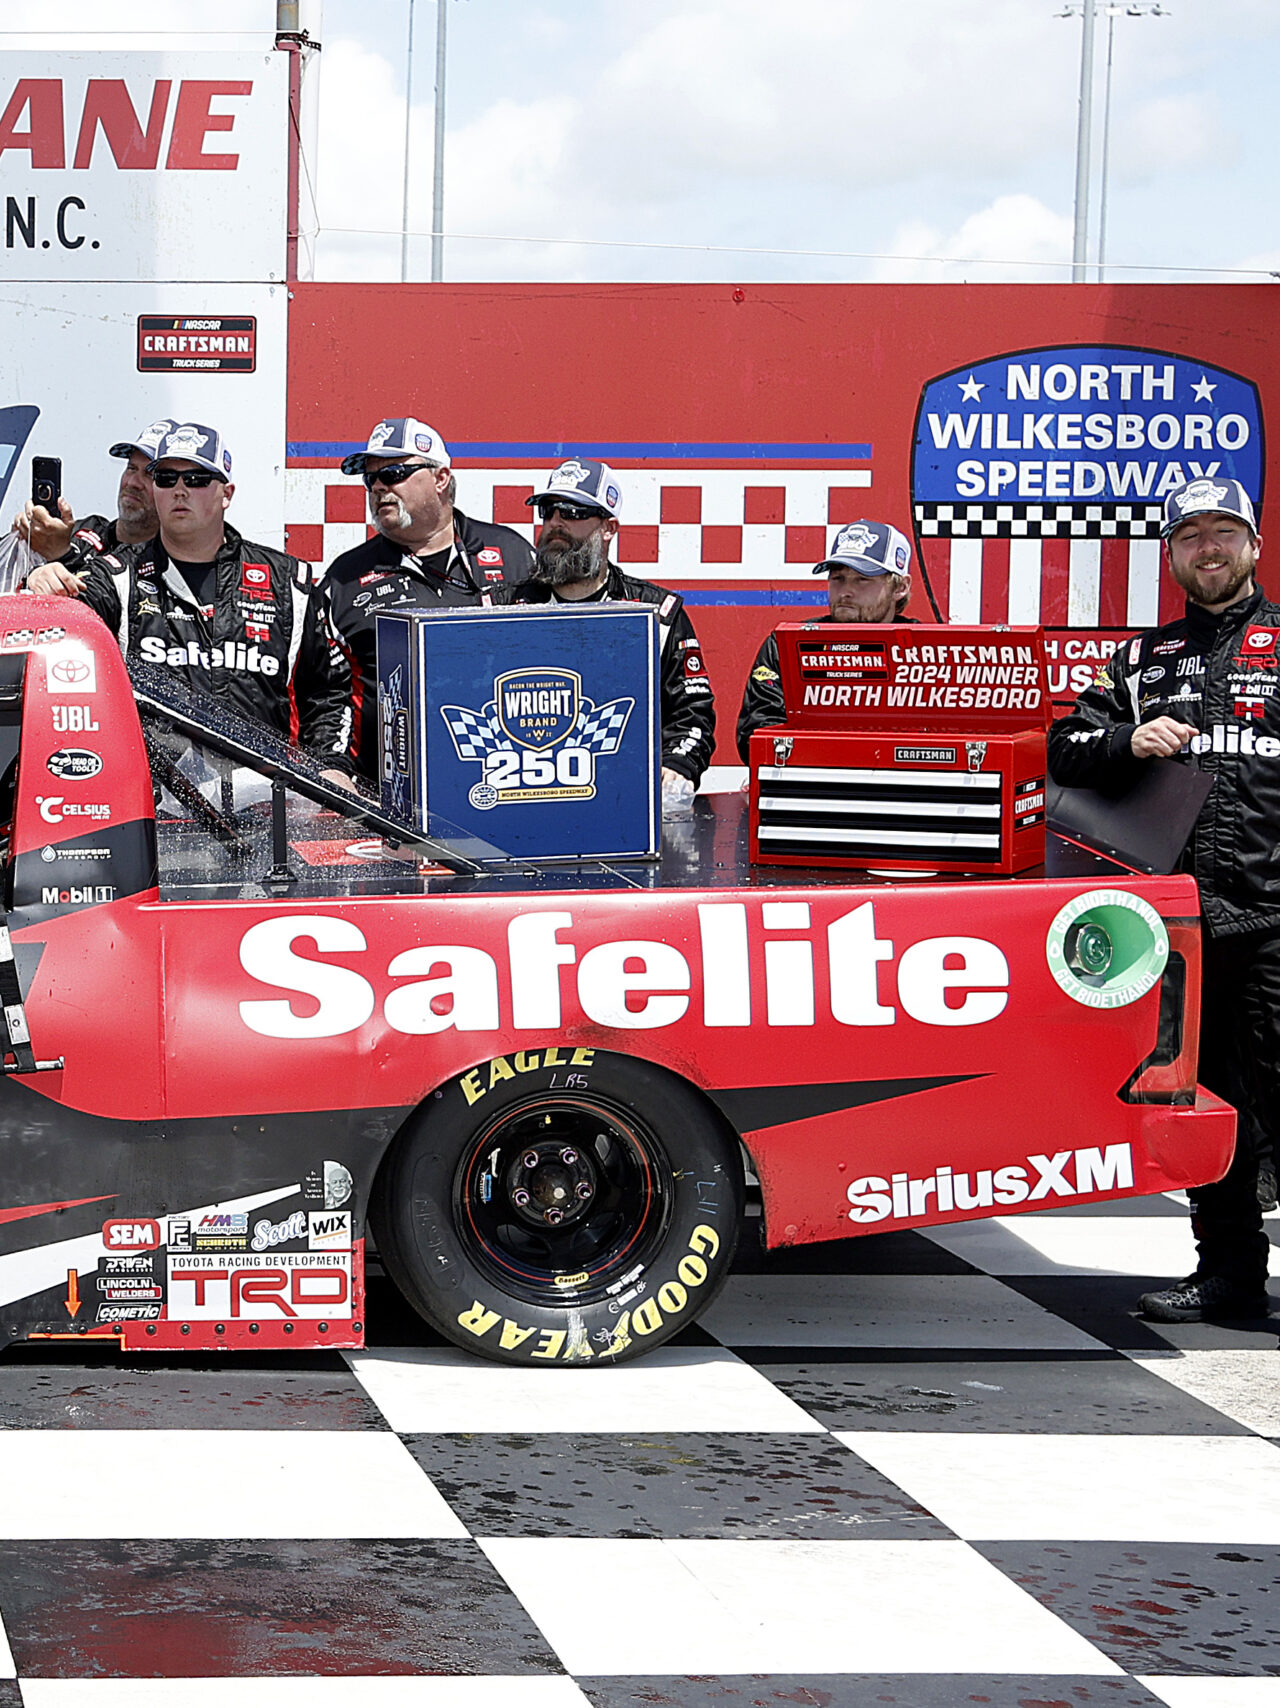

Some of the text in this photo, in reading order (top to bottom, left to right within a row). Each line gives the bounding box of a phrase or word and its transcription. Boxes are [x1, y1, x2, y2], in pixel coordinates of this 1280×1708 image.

[6, 197, 101, 249] N.C.
[185, 320, 221, 330] NASCAR
[144, 336, 249, 352] CRAFTSMAN
[172, 359, 220, 368] TRUCK SERIES
[1006, 364, 1175, 401] NORTH
[927, 413, 1250, 450] WILKESBORO
[140, 636, 279, 676] Safelite
[802, 656, 883, 667] CRAFTSMAN
[891, 645, 1033, 665] CRAFTSMAN
[1176, 655, 1205, 676] JBL
[1232, 657, 1278, 670] TRD
[895, 665, 1039, 685] 2024 WINNER
[504, 690, 572, 719] WRIGHT
[803, 685, 1041, 709] NORTH WILKESBORO
[51, 706, 99, 731] JBL
[520, 717, 558, 727] BRAND
[398, 716, 406, 769] WRIGHT
[72, 758, 86, 766] DEAD
[897, 750, 952, 760] CRAFTSMAN
[72, 765, 96, 773] TOOLS
[486, 747, 591, 789] 250
[62, 805, 110, 815] CELSIUS
[1015, 793, 1043, 814] CRAFTSMAN
[42, 887, 92, 904] Mobil
[1052, 890, 1161, 933] GET BIOETHANOL
[239, 902, 1010, 1039] Safelite
[1054, 968, 1159, 1007] GET BIOETHANOL
[460, 1047, 595, 1106] EAGLE
[847, 1142, 1134, 1223] SiriusXM
[109, 1224, 154, 1245] SEM
[197, 1227, 246, 1236] motorsport
[313, 1215, 347, 1236] WIX
[106, 1257, 152, 1268] DRIVEN
[172, 1256, 347, 1267] TOYOTA RACING DEVELOPMENT
[100, 1279, 150, 1288] LINCOLN
[171, 1269, 347, 1318] TRD
[458, 1224, 720, 1358] GOODYEAR
[100, 1304, 159, 1318] COMETIC
